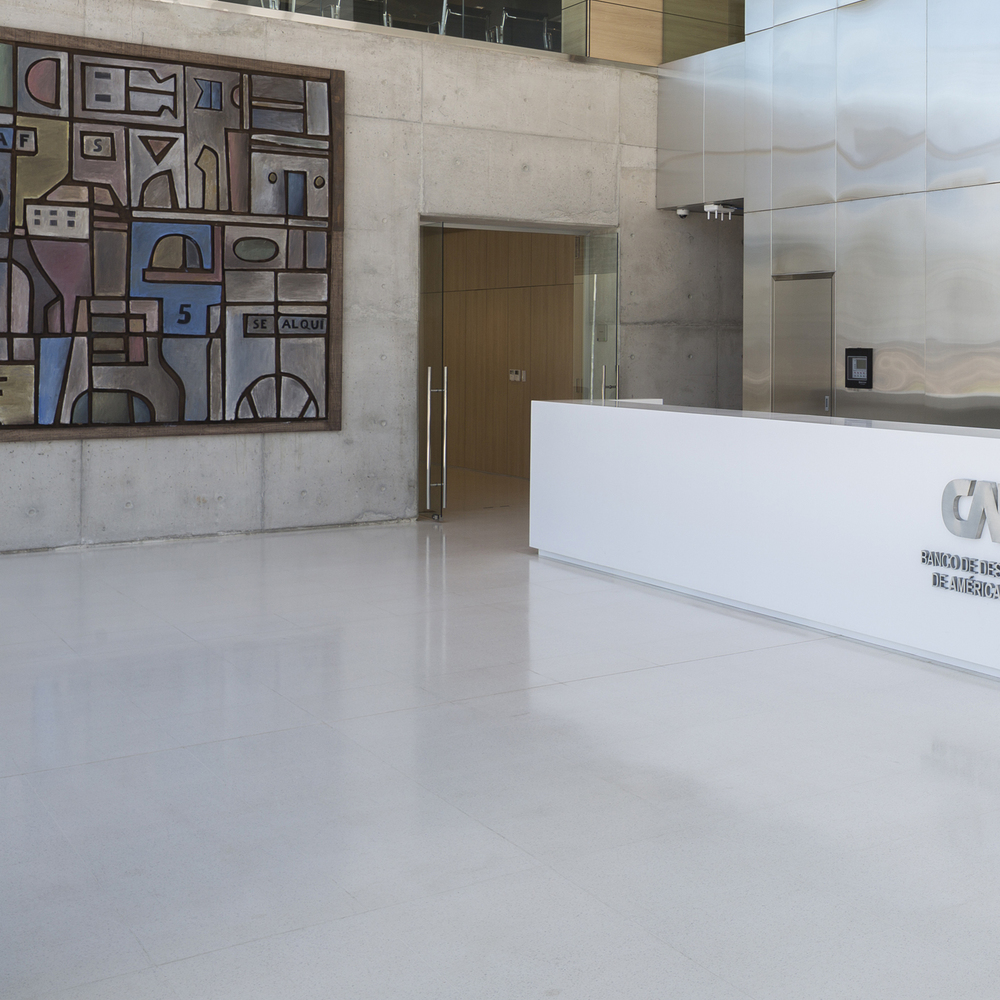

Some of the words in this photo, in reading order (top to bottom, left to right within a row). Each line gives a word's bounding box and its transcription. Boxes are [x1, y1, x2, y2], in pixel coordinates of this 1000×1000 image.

[93, 138, 103, 152] S
[176, 303, 192, 325] 5
[252, 319, 267, 330] SE
[281, 318, 325, 331] ALQUI
[920, 549, 961, 571] BANCO
[961, 556, 979, 575] DE
[931, 571, 949, 590] DE
